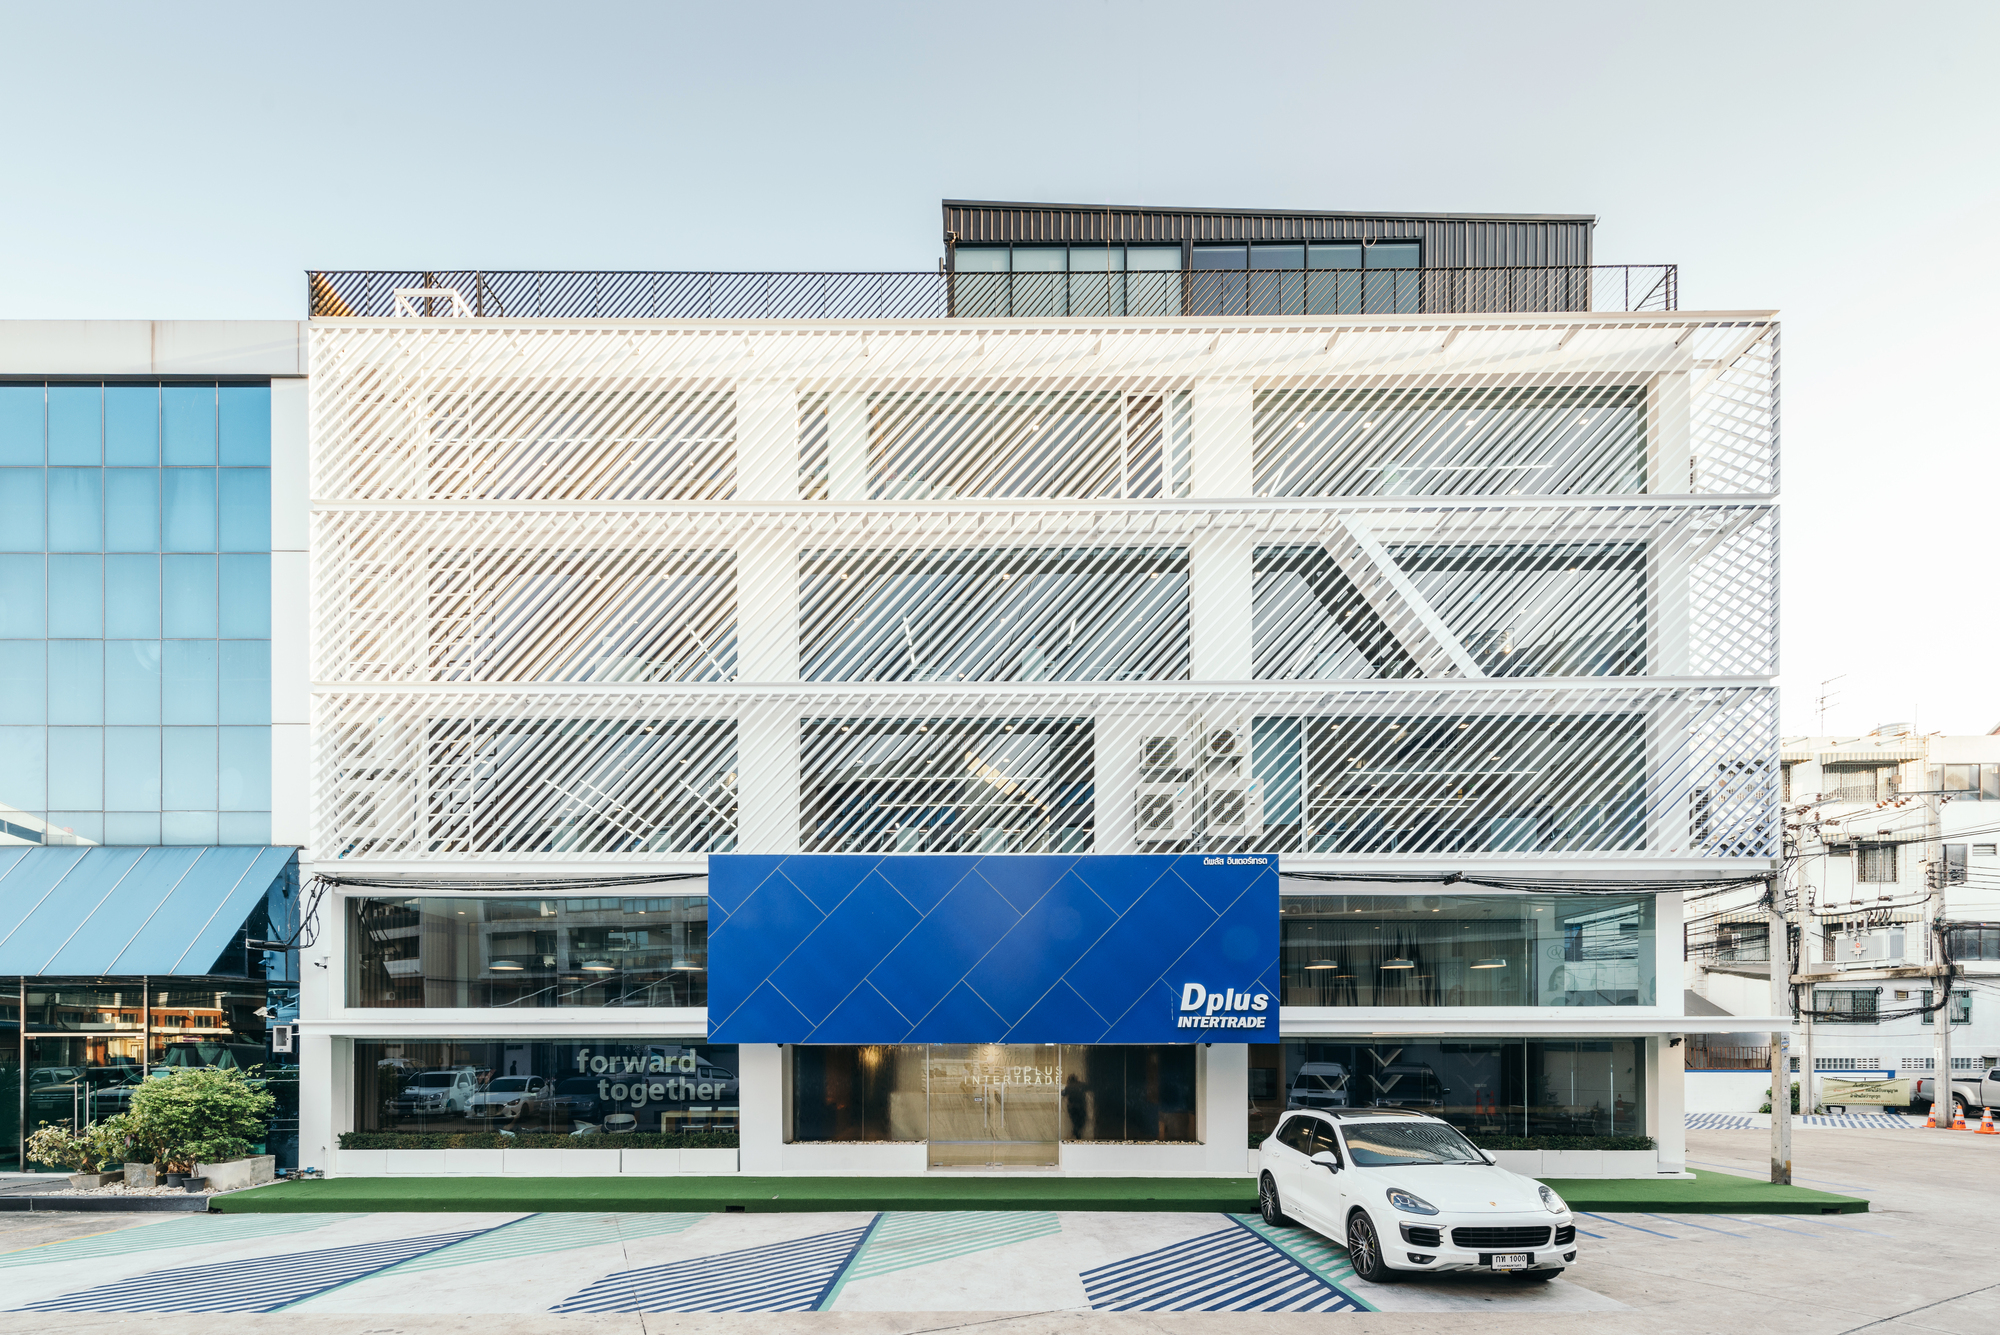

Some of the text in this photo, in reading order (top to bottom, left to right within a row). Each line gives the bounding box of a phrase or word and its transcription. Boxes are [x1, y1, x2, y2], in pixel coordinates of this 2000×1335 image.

[1180, 983, 1269, 1016] Dplus
[1177, 1016, 1267, 1028] INTERTRADE
[576, 1048, 697, 1073] forward
[1013, 1065, 1063, 1076] DPLUS
[964, 1075, 1063, 1085] INTERTRADE
[597, 1076, 726, 1108] together
[1510, 1254, 1526, 1262] 1000
